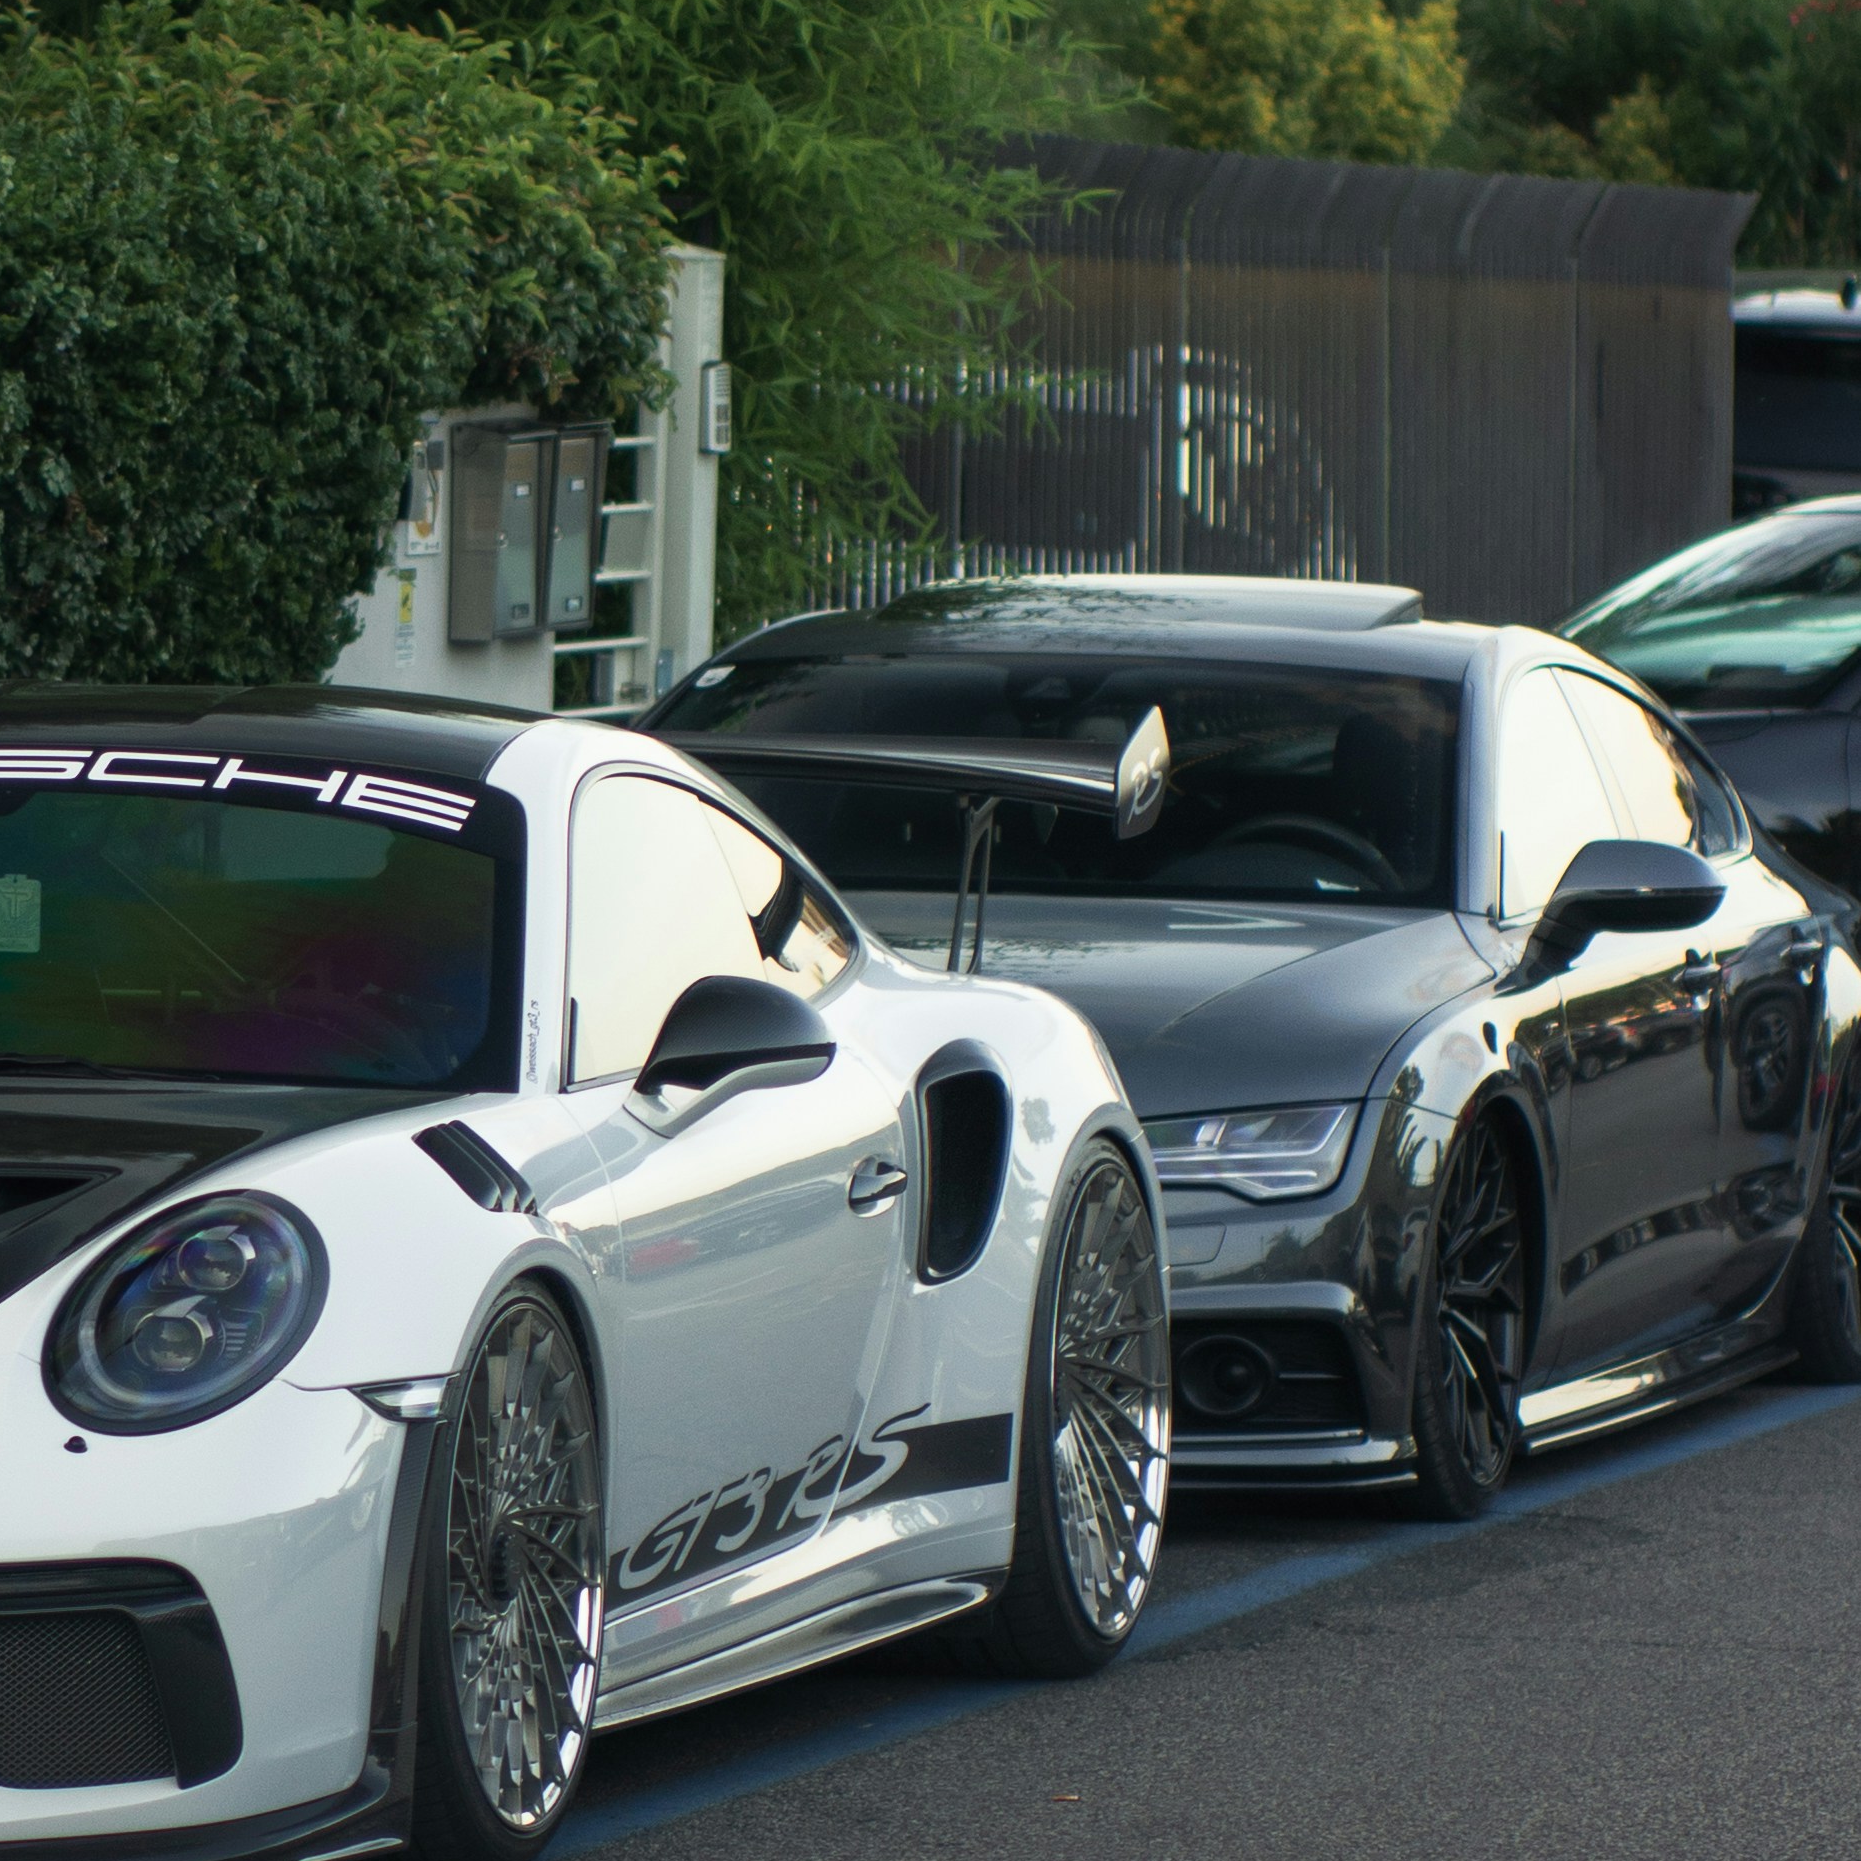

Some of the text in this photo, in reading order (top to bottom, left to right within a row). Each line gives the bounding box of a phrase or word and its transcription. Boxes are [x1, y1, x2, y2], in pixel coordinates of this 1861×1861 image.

[1126, 746, 1164, 826] RS
[619, 1401, 932, 1591] GT3 RS
